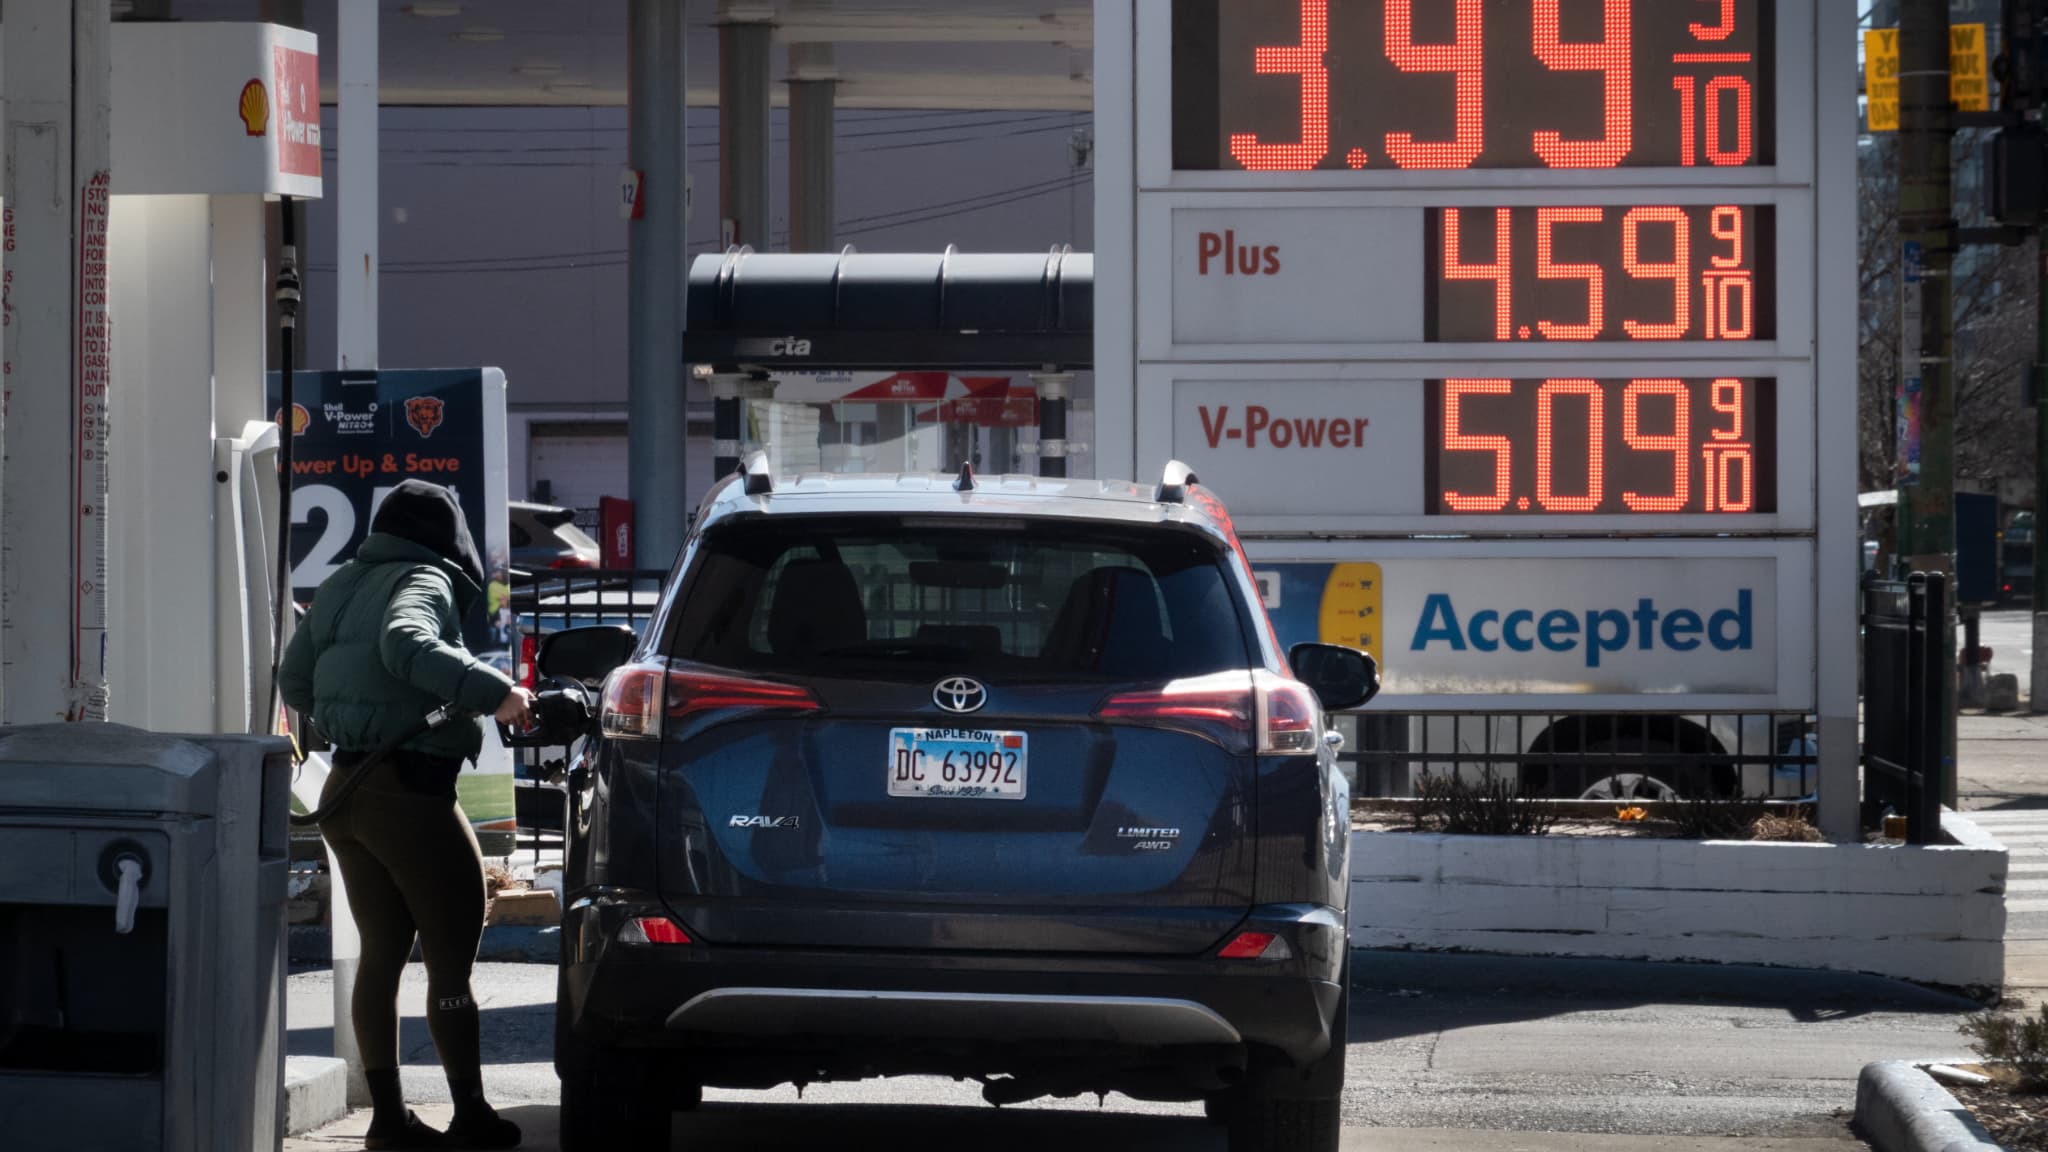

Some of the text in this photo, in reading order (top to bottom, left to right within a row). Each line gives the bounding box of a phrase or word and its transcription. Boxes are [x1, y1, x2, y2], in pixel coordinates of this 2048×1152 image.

[1231, 0, 1632, 170] 3.99
[1672, 75, 1752, 167] 10
[87, 188, 107, 201] STO
[622, 184, 635, 204] 12
[1198, 231, 1281, 276] Plus
[1711, 206, 1743, 269] 9
[1444, 206, 1690, 341] 4.59
[1702, 276, 1752, 340] 10
[84, 340, 98, 352] TO
[770, 336, 811, 356] cta
[325, 411, 375, 422] V-Power
[1198, 404, 1369, 449] V-Power
[1711, 378, 1744, 440] 9
[1444, 378, 1690, 513] 5.09
[342, 454, 376, 478] Up
[381, 453, 398, 473] &
[405, 453, 460, 473] Save
[1703, 447, 1752, 513] 10
[1410, 588, 1752, 668] Accepted
[925, 728, 993, 743] NAPLETON
[896, 749, 1018, 783] DC 63992
[728, 814, 801, 830] RAV4
[1116, 826, 1181, 838] LIMITED
[1133, 840, 1172, 850] AWD
